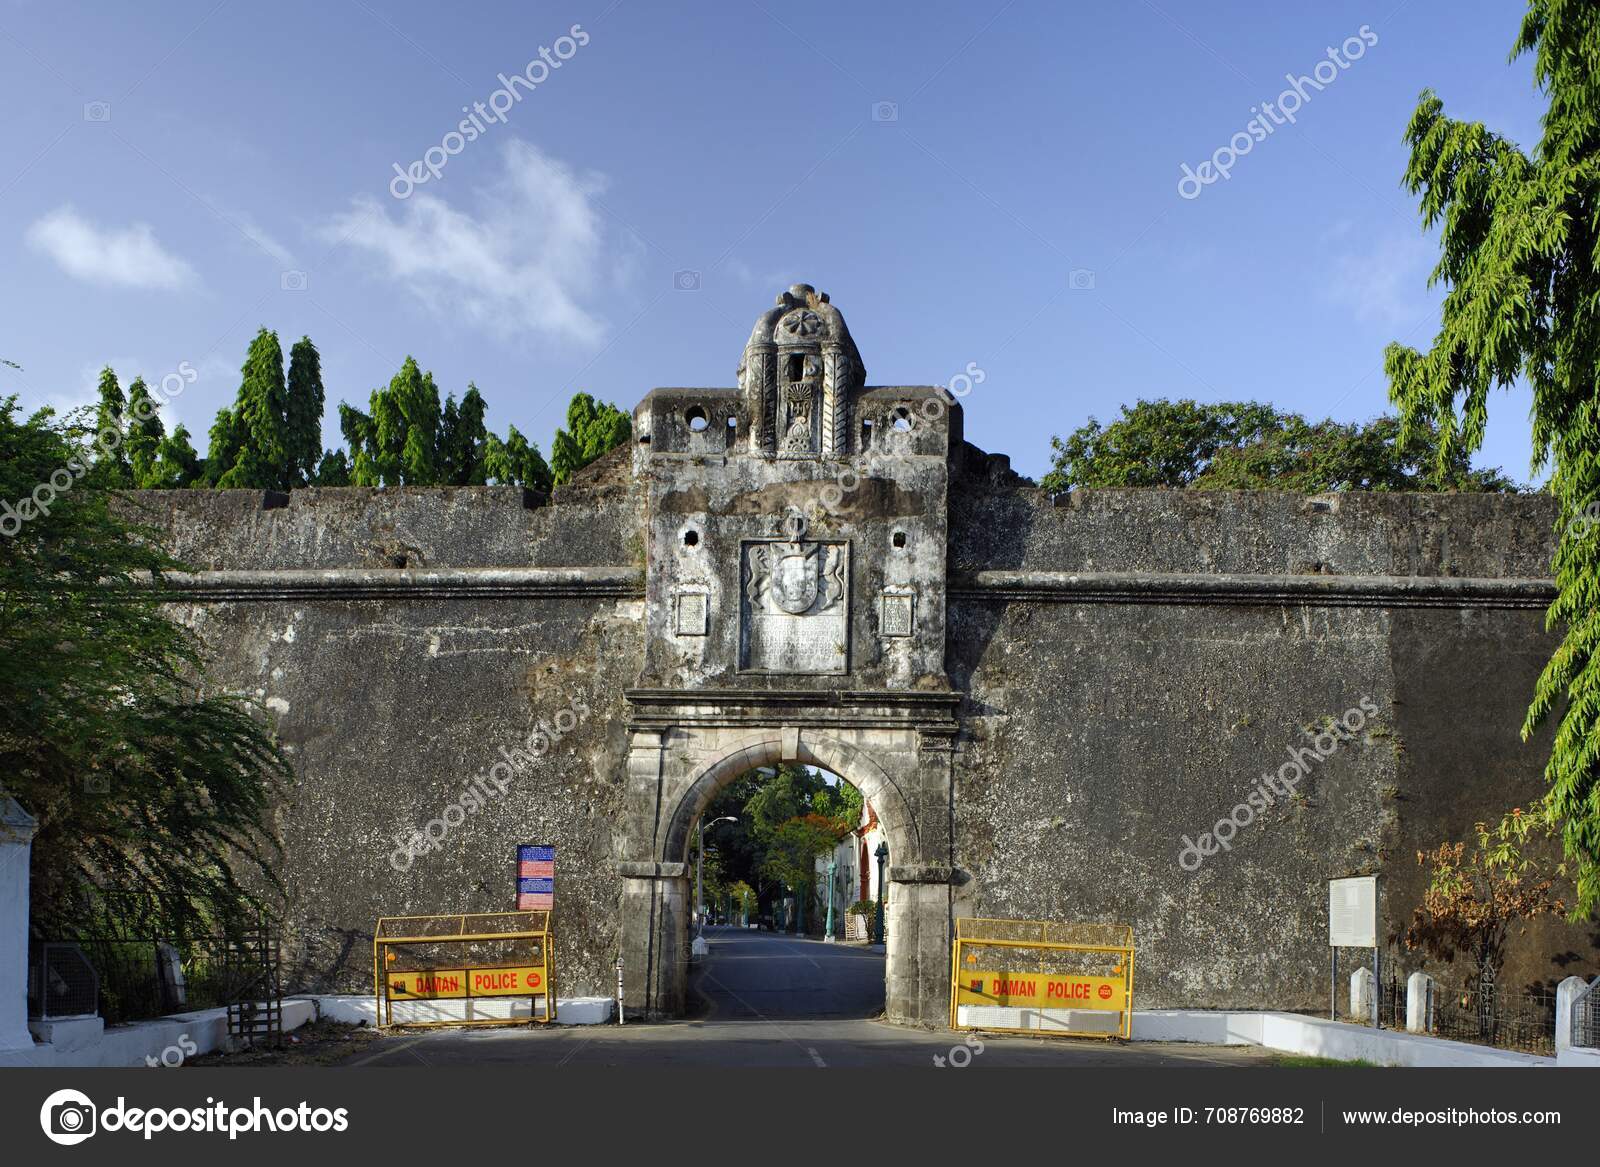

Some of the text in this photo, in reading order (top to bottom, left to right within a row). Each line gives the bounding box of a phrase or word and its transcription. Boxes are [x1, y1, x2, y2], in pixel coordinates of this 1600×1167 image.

[416, 976, 459, 993] DAMAN
[475, 973, 518, 990] POLICE
[992, 979, 1036, 997] DAMAN
[1047, 981, 1090, 1000] POLICE
